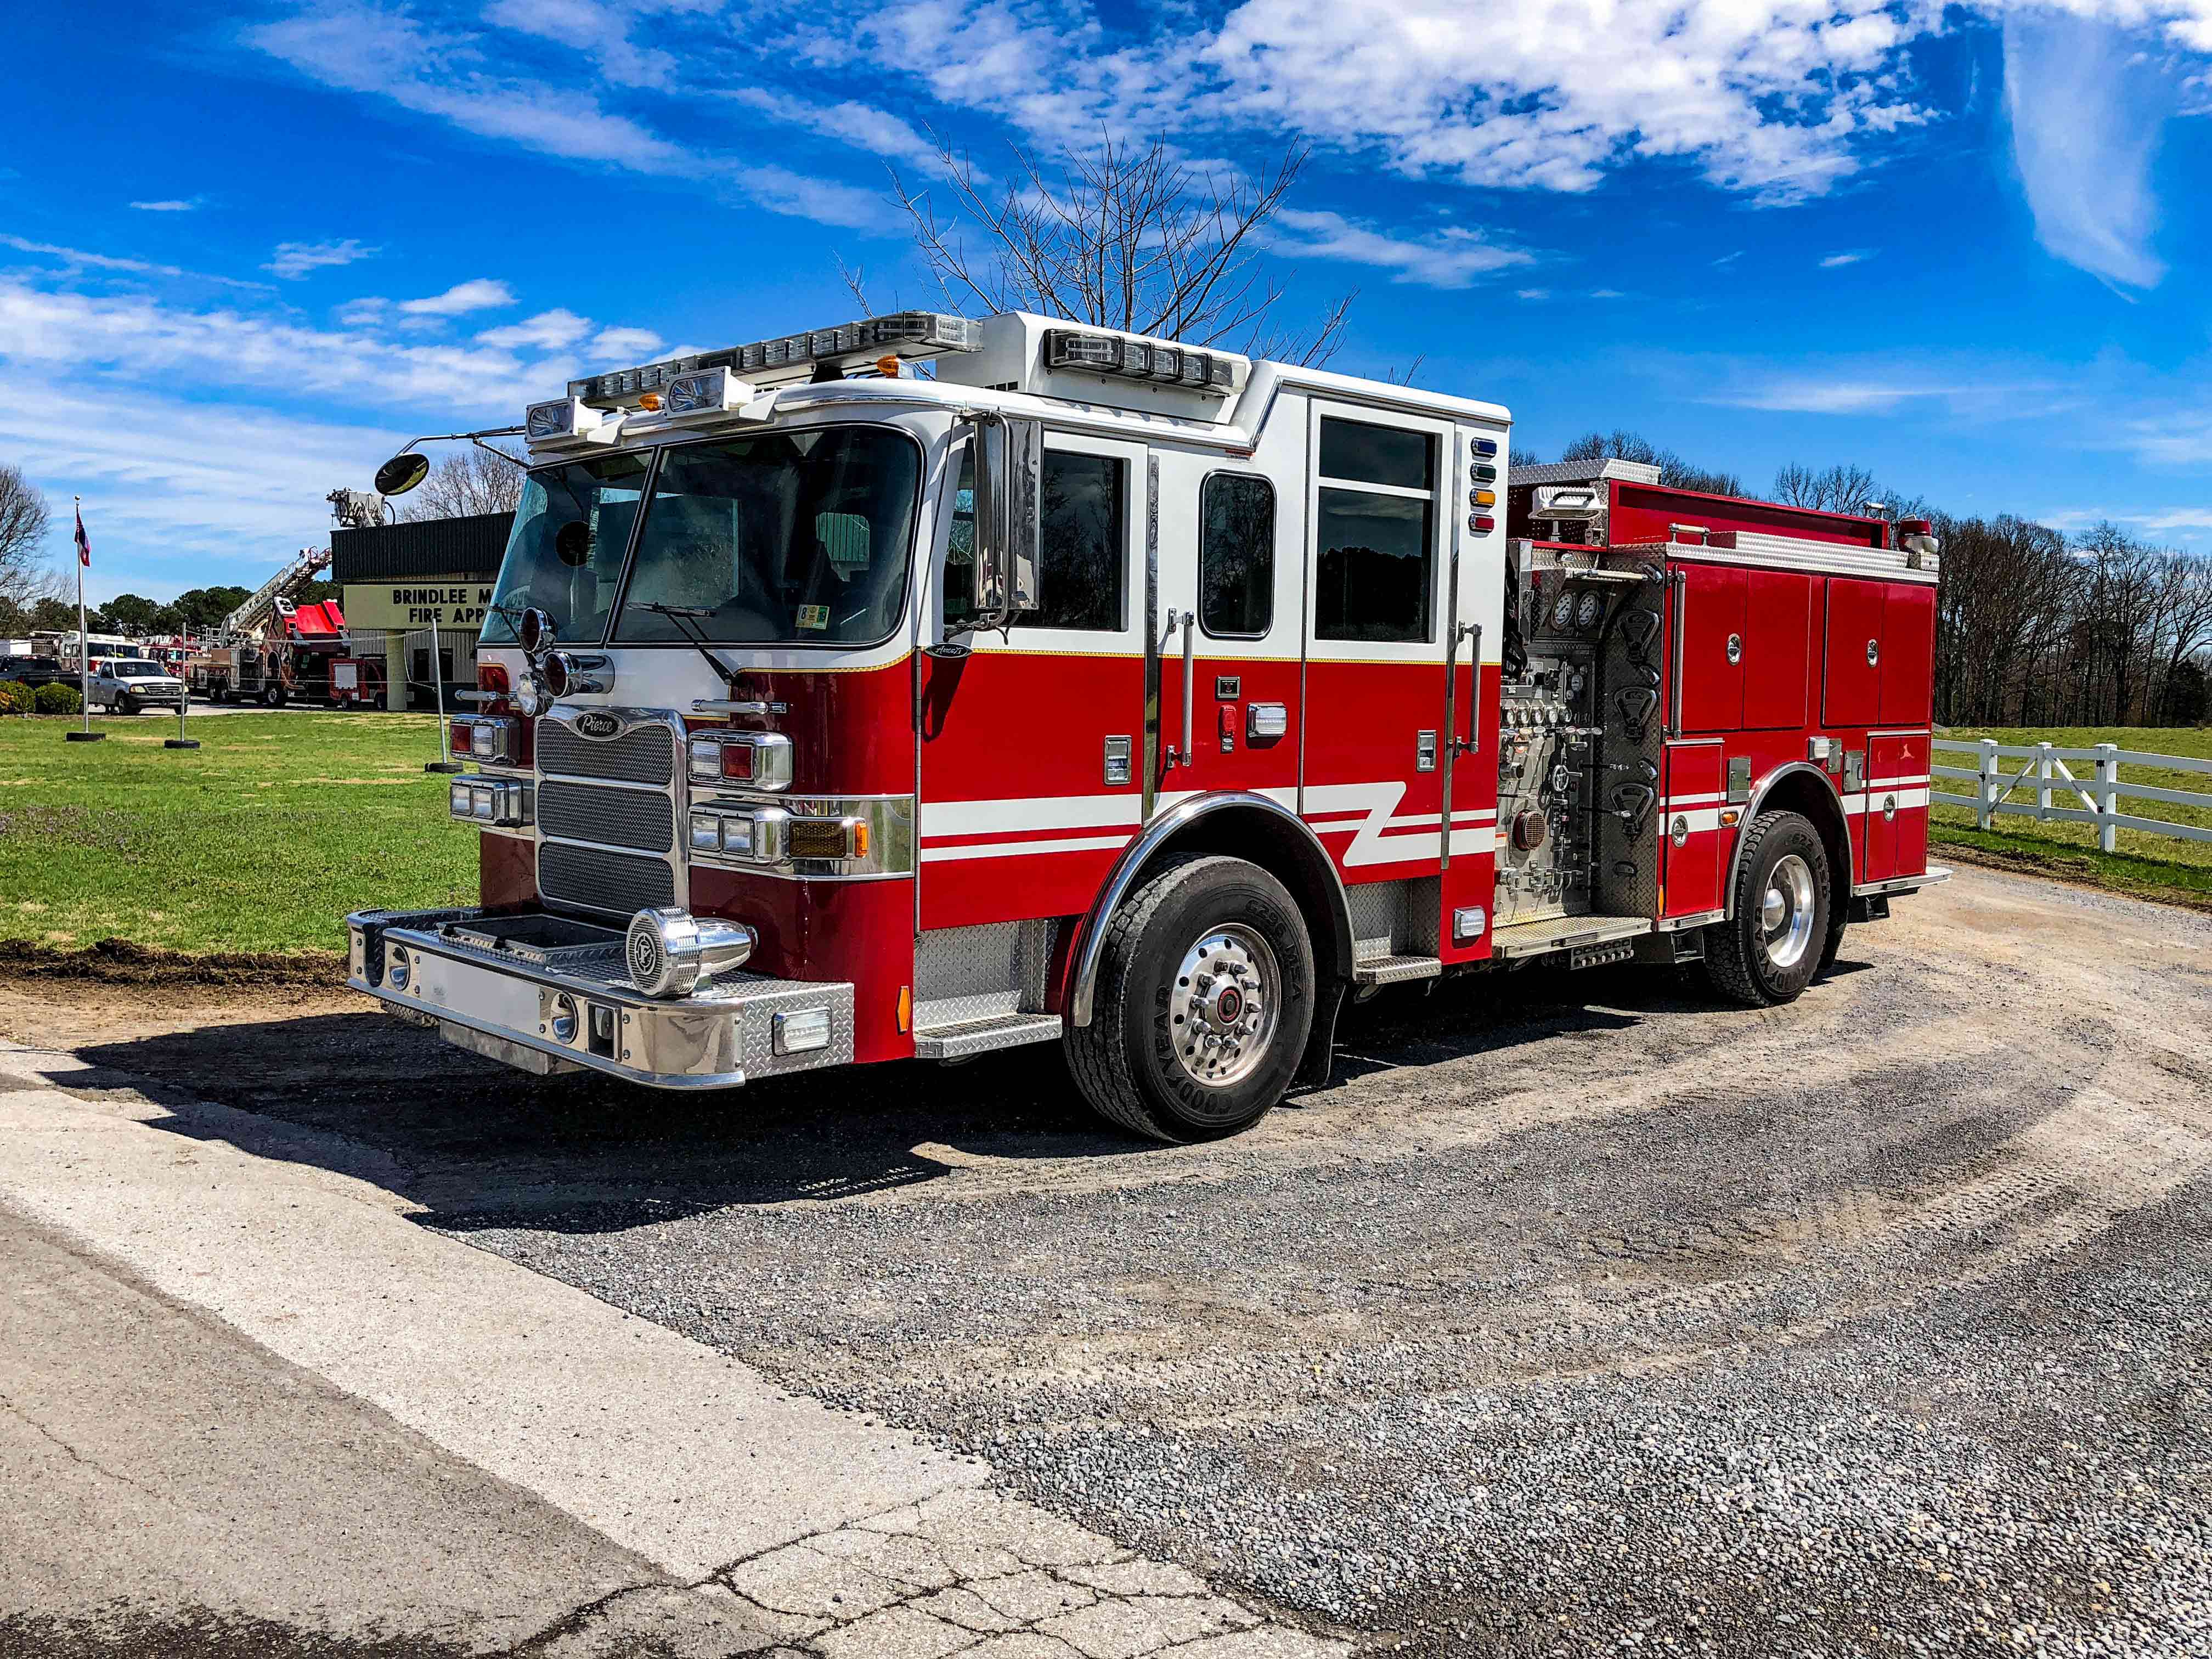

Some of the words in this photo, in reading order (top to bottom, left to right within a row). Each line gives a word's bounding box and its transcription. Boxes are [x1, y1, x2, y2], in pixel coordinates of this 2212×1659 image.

[393, 589, 467, 604] BRINDLEE
[478, 589, 493, 604] M
[409, 607, 442, 623] FIRE
[453, 607, 485, 623] APP
[801, 607, 807, 619] 8
[582, 714, 613, 733] Pierce
[1154, 985, 1233, 1115] GOODYEAR
